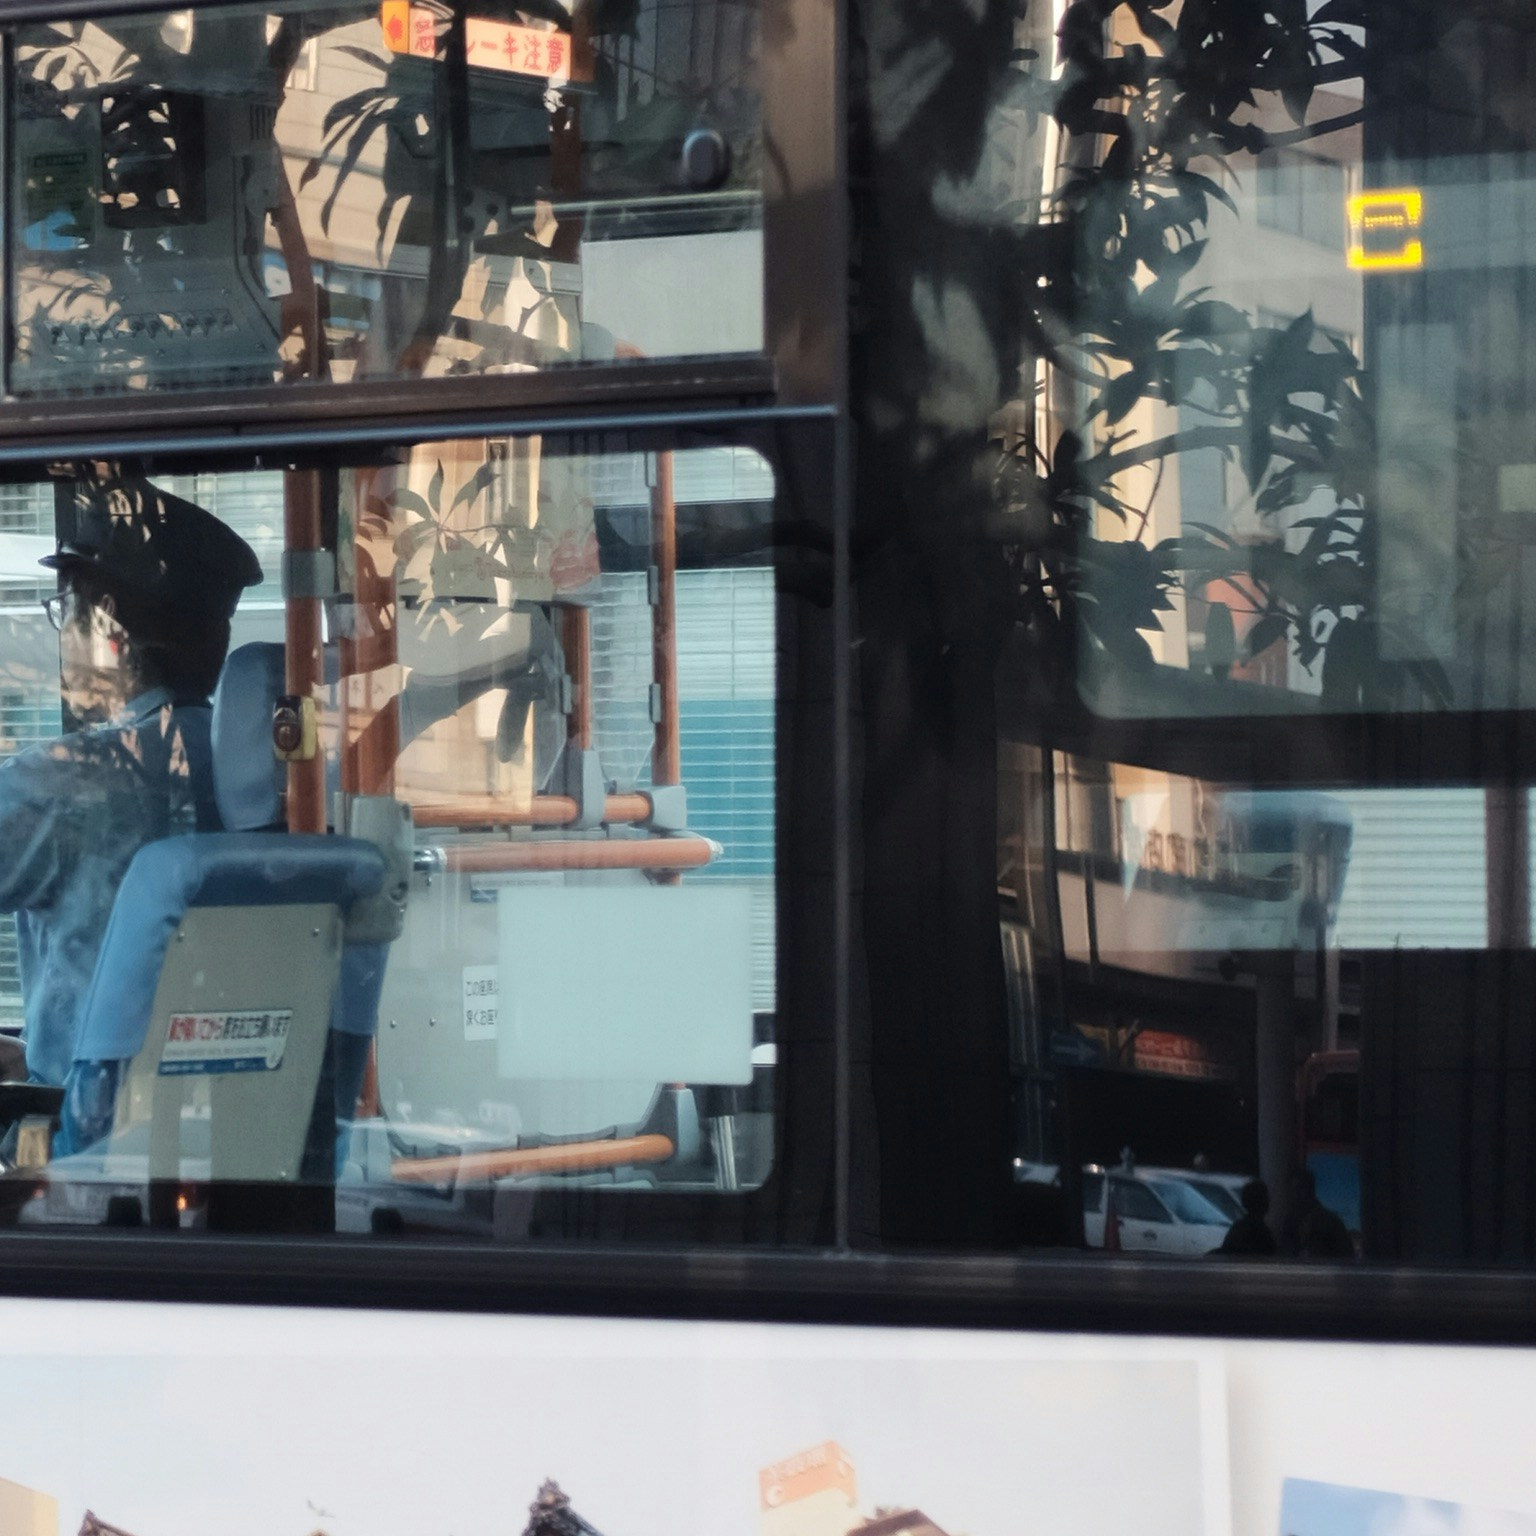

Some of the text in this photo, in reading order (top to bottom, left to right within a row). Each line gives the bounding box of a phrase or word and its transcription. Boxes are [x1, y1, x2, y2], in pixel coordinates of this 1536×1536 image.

[415, 17, 564, 74] 急ーキ注意
